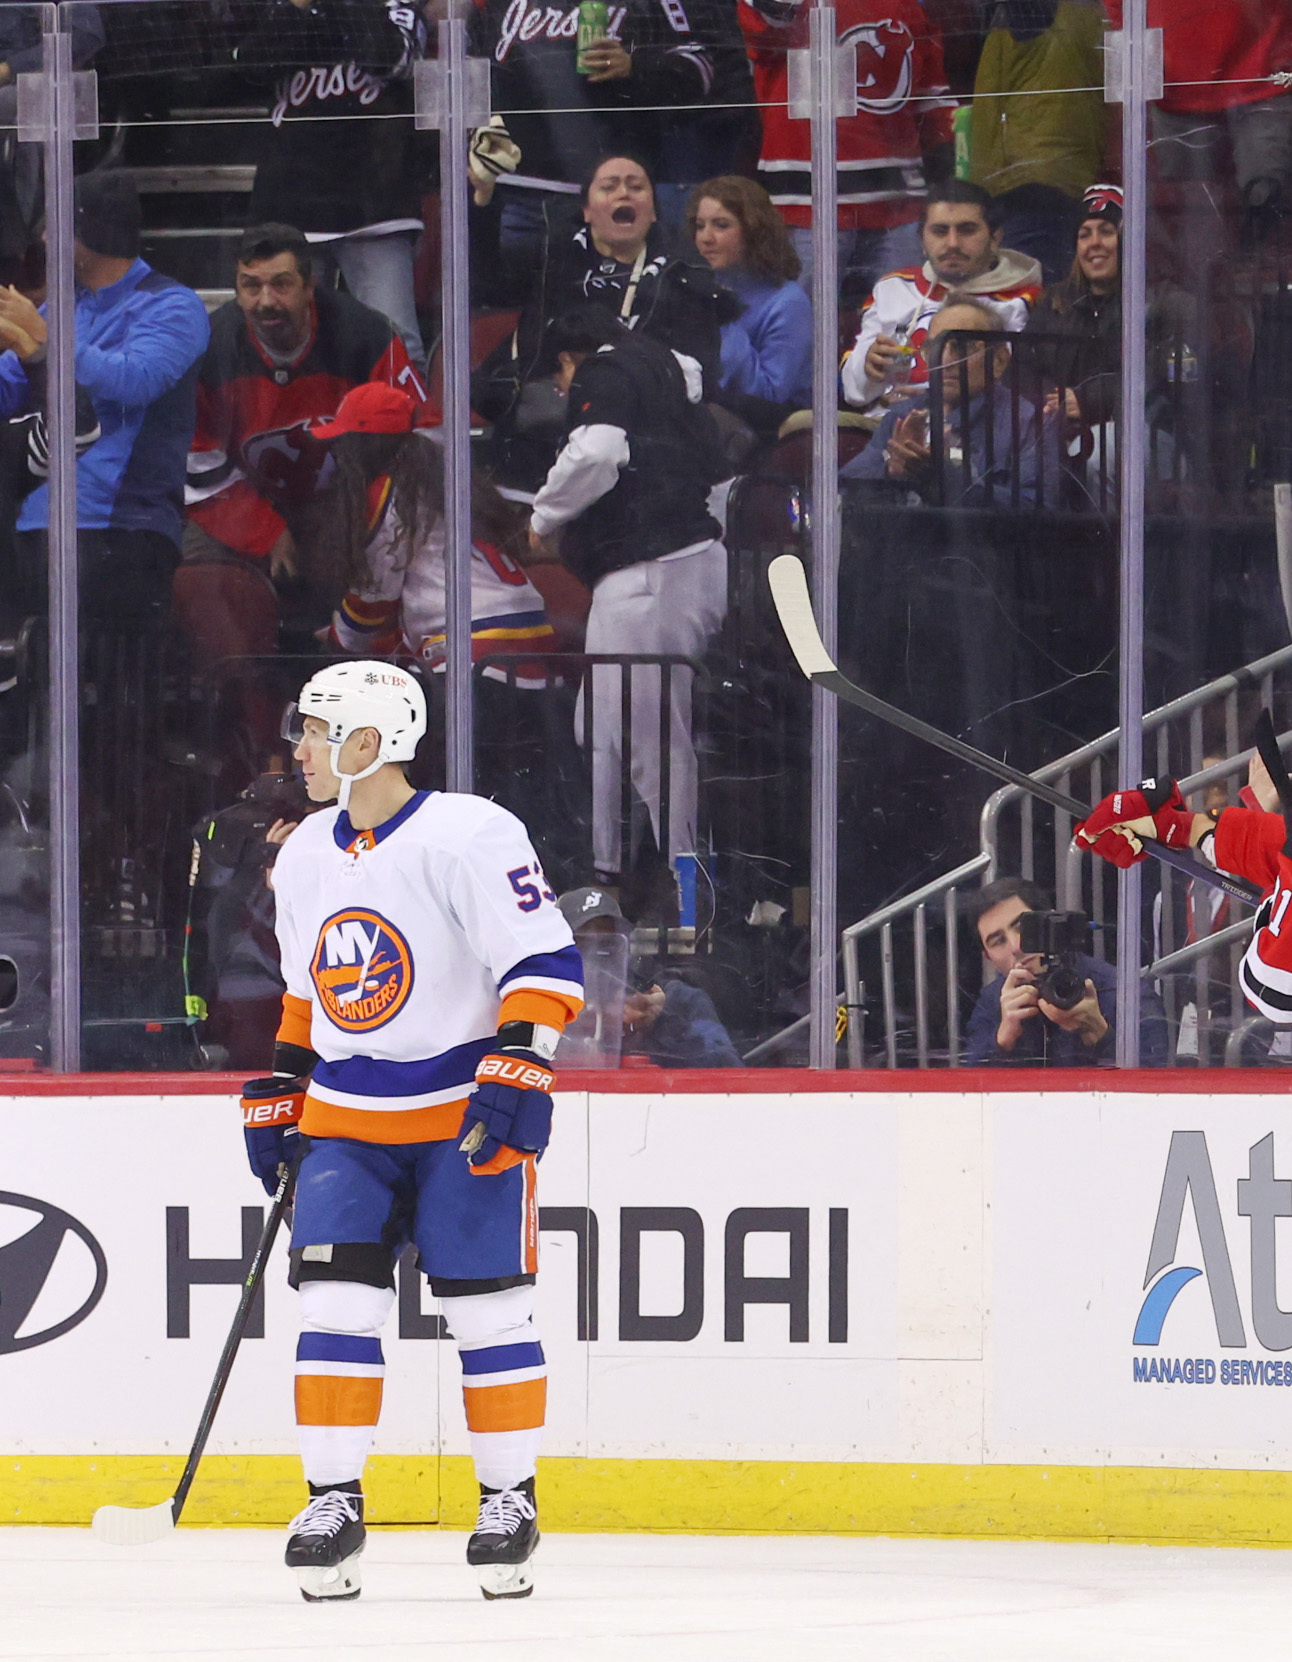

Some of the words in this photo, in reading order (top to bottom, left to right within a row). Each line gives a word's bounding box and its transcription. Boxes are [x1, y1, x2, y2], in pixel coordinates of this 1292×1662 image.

[495, 0, 628, 62] Jersy
[381, 674, 408, 688] UBS
[475, 1059, 553, 1091] BAUER
[241, 1099, 294, 1124] UER
[166, 1205, 849, 1344] HNDAI
[1132, 1357, 1216, 1385] MANAGED
